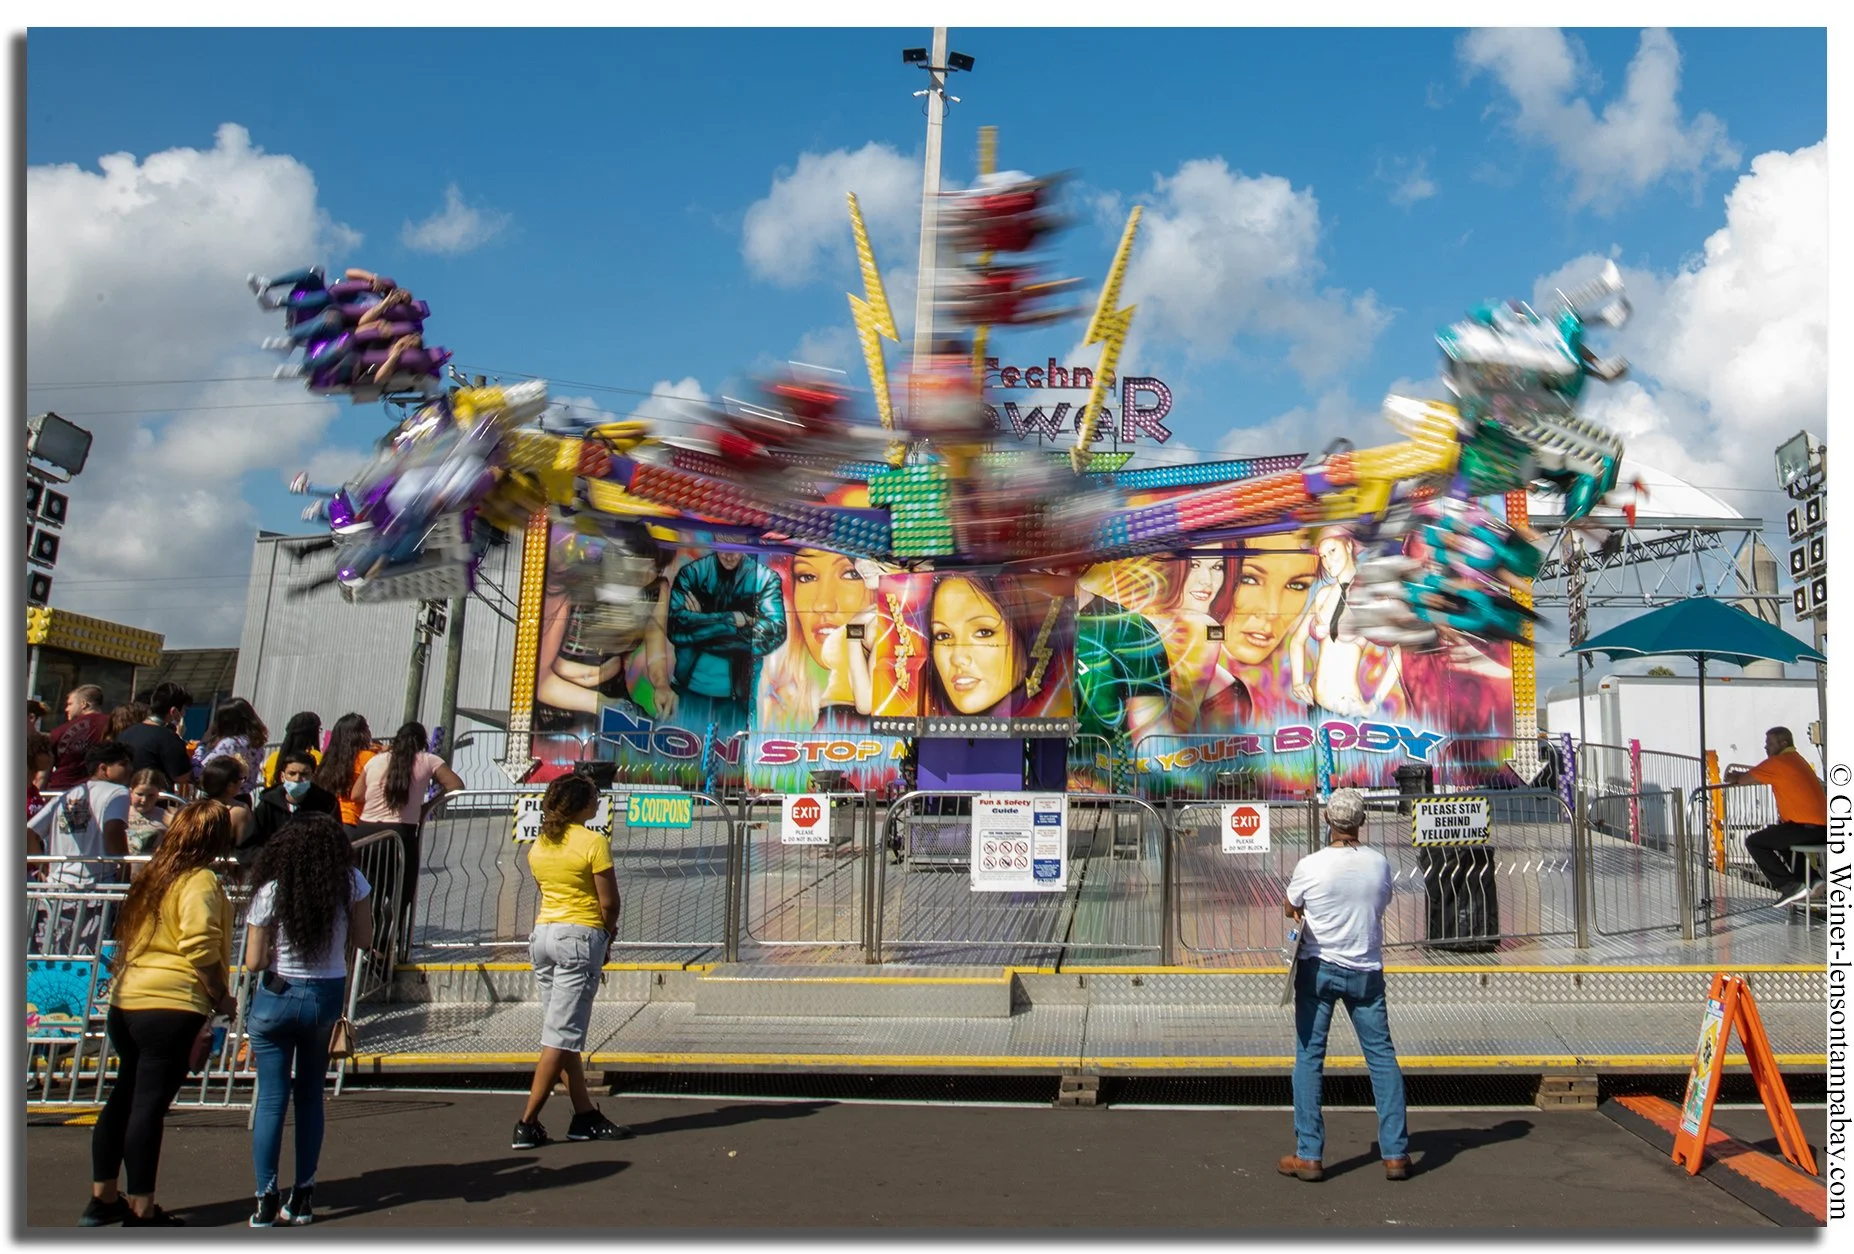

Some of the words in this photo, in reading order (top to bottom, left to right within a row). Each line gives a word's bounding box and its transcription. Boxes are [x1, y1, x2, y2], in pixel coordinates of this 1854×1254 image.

[755, 739, 883, 765] STOP
[1154, 735, 1267, 772] YOUR
[1273, 719, 1447, 762] BODY
[1004, 799, 1031, 807] Safety
[1421, 804, 1457, 815] PLEASE
[1459, 803, 1481, 814] STAY
[629, 797, 640, 822] 5
[641, 798, 691, 824] COUPONS
[792, 806, 820, 819] EXIT
[1232, 815, 1259, 828] EXIT
[1435, 816, 1471, 827] BEHIND
[1421, 828, 1462, 840] YELLOW
[1463, 827, 1488, 839] LINES
